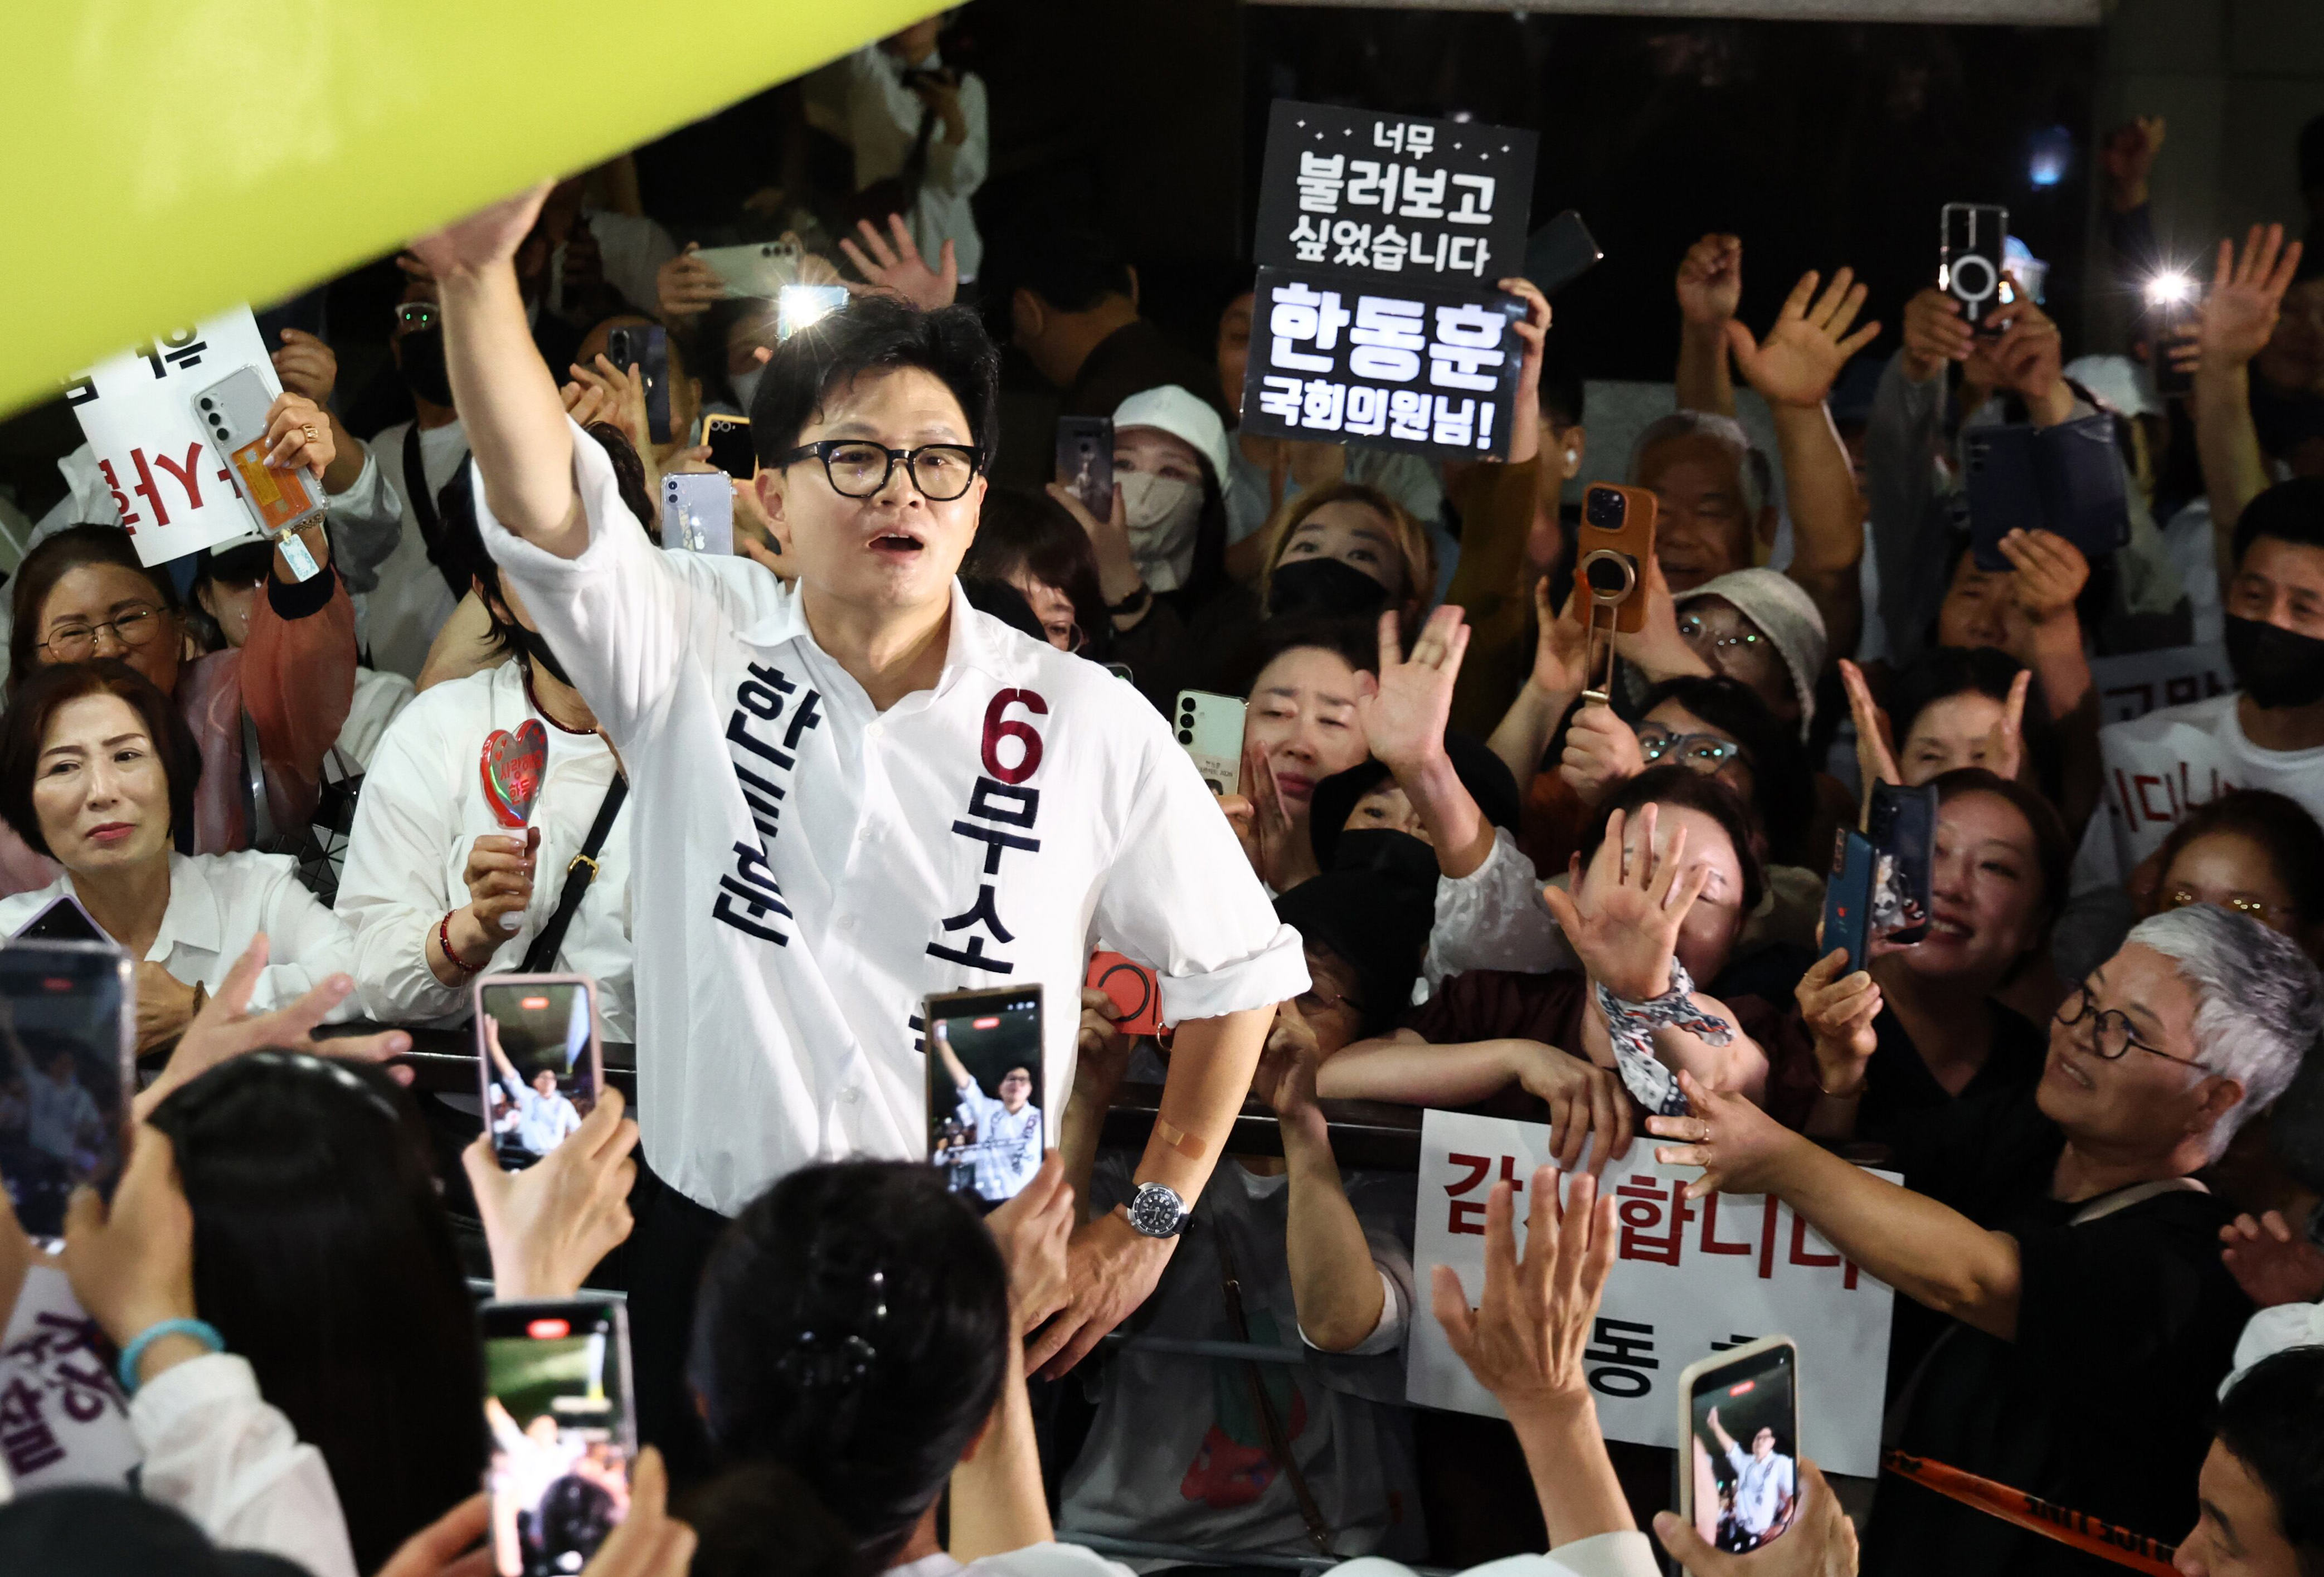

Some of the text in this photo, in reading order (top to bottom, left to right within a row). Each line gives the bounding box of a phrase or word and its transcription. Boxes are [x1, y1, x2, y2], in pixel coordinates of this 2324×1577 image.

[1374, 121, 1435, 159] 너무
[1297, 151, 1495, 224] 불러보고
[1289, 215, 1491, 277] 싶었습니다
[1271, 282, 1506, 392] 한동훈
[1260, 376, 1495, 450] 국회의원님!
[908, 775, 1041, 1053] 무소
